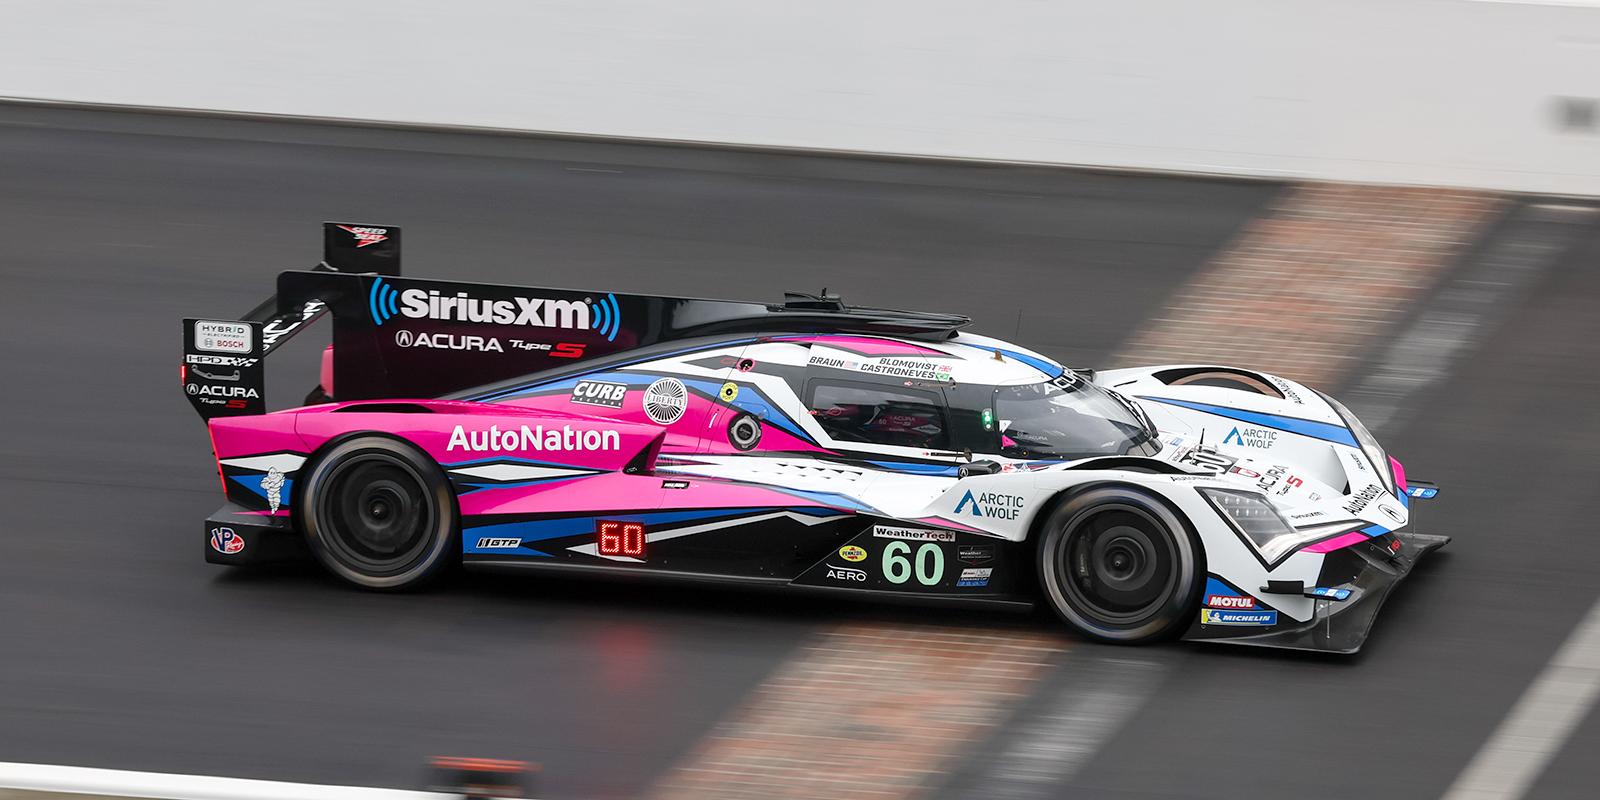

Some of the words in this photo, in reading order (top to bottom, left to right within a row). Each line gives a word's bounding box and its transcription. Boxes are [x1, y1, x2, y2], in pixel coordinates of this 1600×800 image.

[352, 226, 388, 235] SPEED
[217, 340, 244, 348] BOSCH
[413, 332, 504, 353] ACURA
[509, 339, 552, 351] Type
[549, 342, 587, 358] S
[188, 355, 223, 364] HPD
[809, 356, 845, 368] BRAUN
[879, 357, 939, 372] BLOMQVIST
[860, 363, 936, 380] CASTRONEVES
[199, 385, 259, 399] ACURA
[573, 382, 627, 401] CURB
[225, 399, 249, 409] S
[446, 425, 620, 451] AutoNation
[1242, 428, 1279, 441] ARCTIC
[1246, 438, 1275, 450] WOLF
[978, 493, 1025, 509] ARCTIC
[984, 505, 1020, 521] WOLF
[211, 527, 234, 552] VP
[601, 522, 642, 555] 60
[876, 527, 954, 541] WeatherTech
[490, 539, 520, 547] GTP
[881, 540, 945, 587] 60
[826, 569, 868, 583] AERO
[1209, 596, 1253, 609] MOTUL
[1222, 614, 1272, 622] MICHELIN
